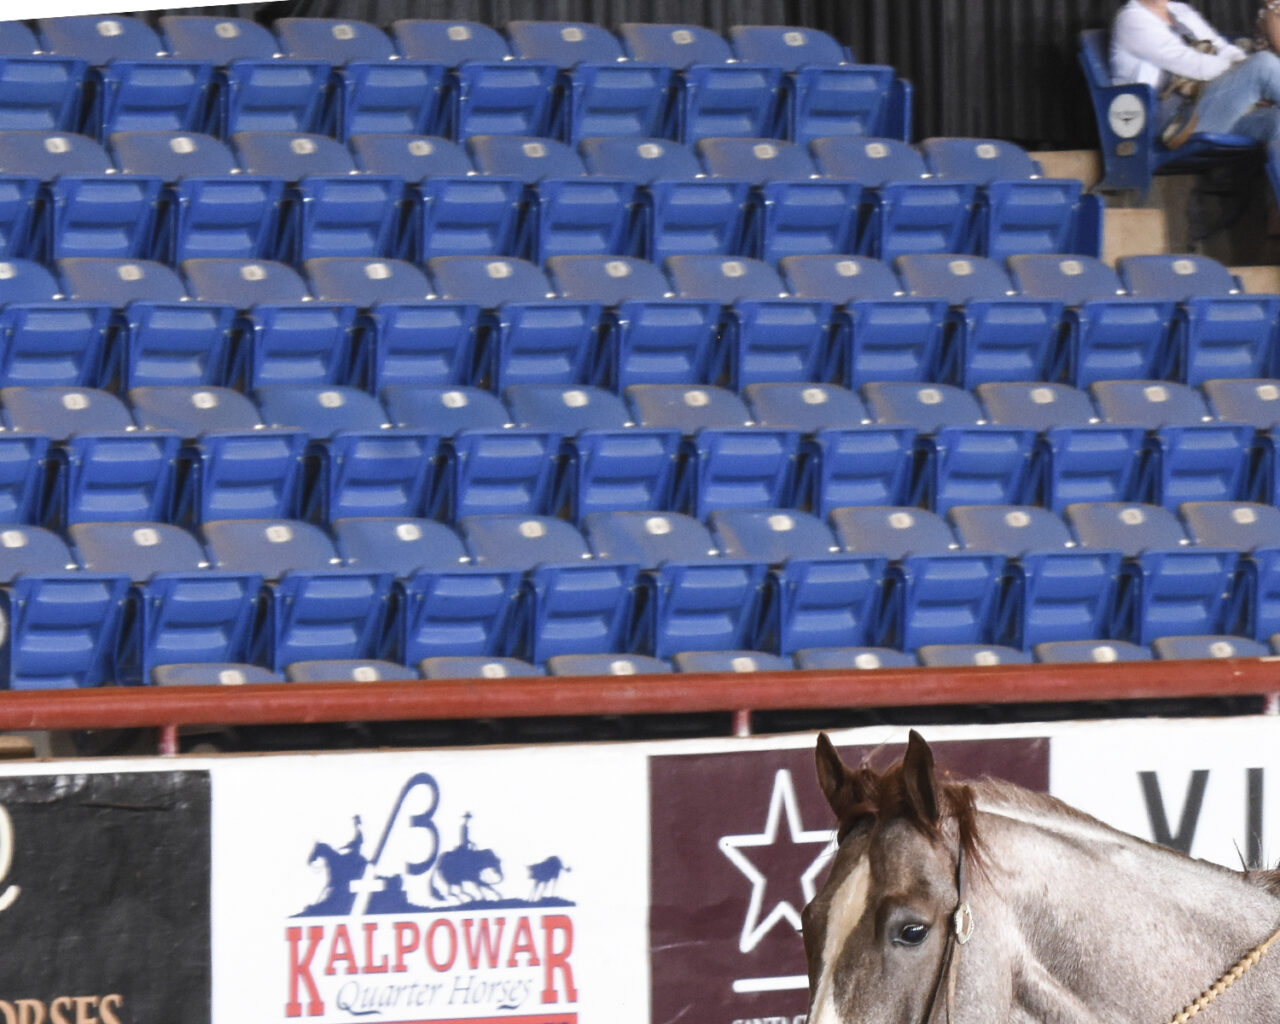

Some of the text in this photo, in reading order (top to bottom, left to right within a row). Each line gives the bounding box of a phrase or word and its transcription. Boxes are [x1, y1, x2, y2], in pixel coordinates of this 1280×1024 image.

[285, 914, 578, 1018] KALPOWAR
[335, 973, 535, 1016] Quarter Horses
